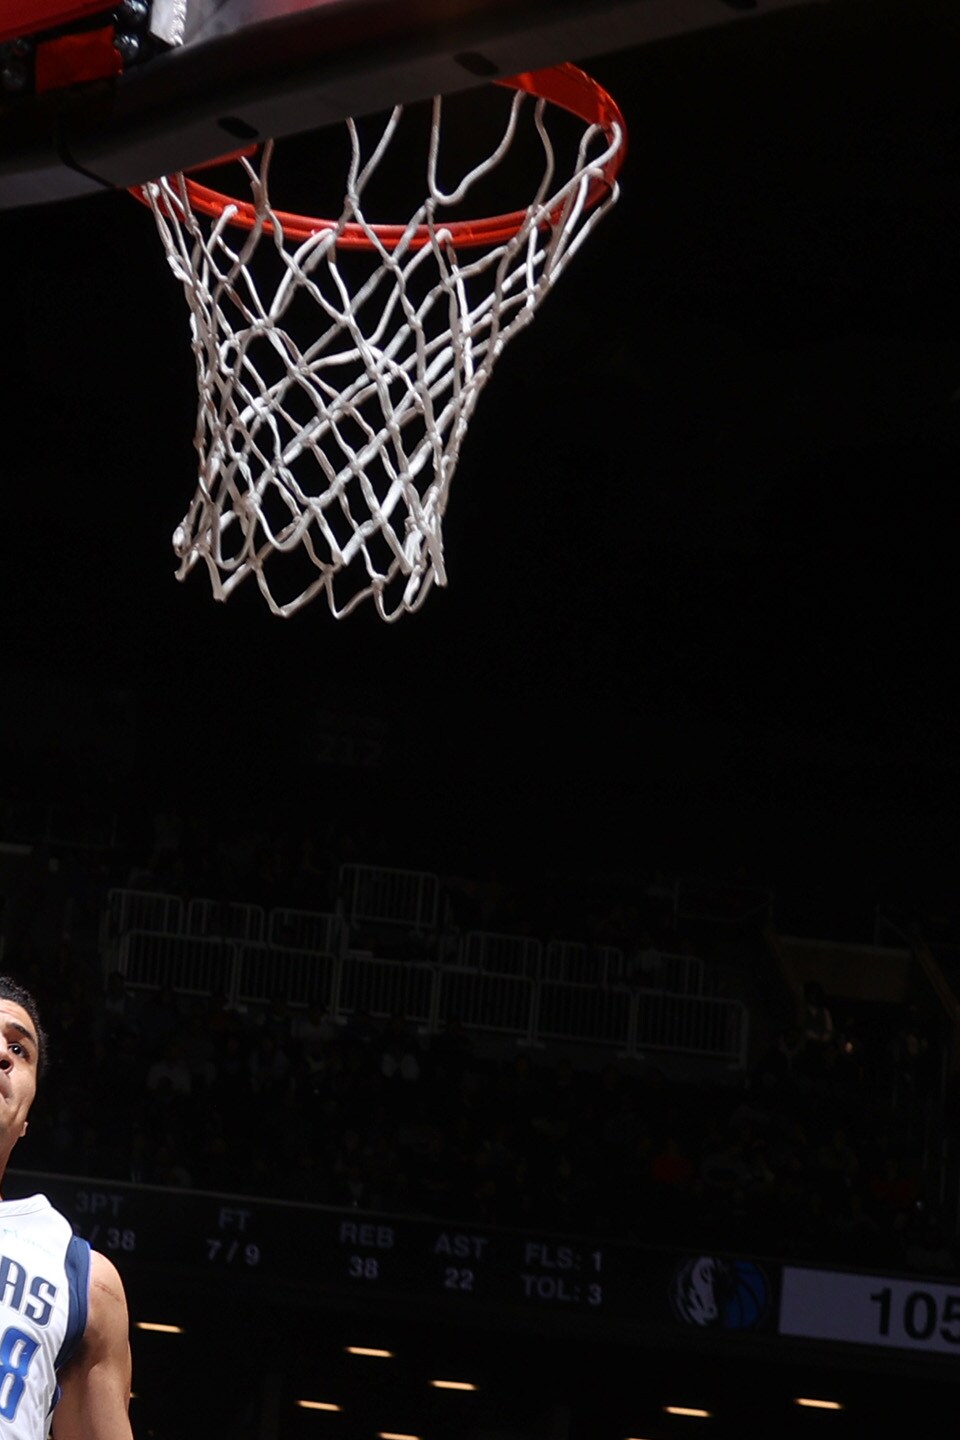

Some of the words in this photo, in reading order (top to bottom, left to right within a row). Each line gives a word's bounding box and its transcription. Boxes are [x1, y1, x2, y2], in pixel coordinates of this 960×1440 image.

[75, 1190, 124, 1217] 3PT
[218, 1207, 252, 1231] FT
[339, 1220, 396, 1250] REB
[433, 1232, 489, 1259] AST
[591, 1250, 603, 1273] 1
[348, 1254, 381, 1280] 38
[443, 1266, 476, 1291] 22
[589, 1282, 604, 1306] 3
